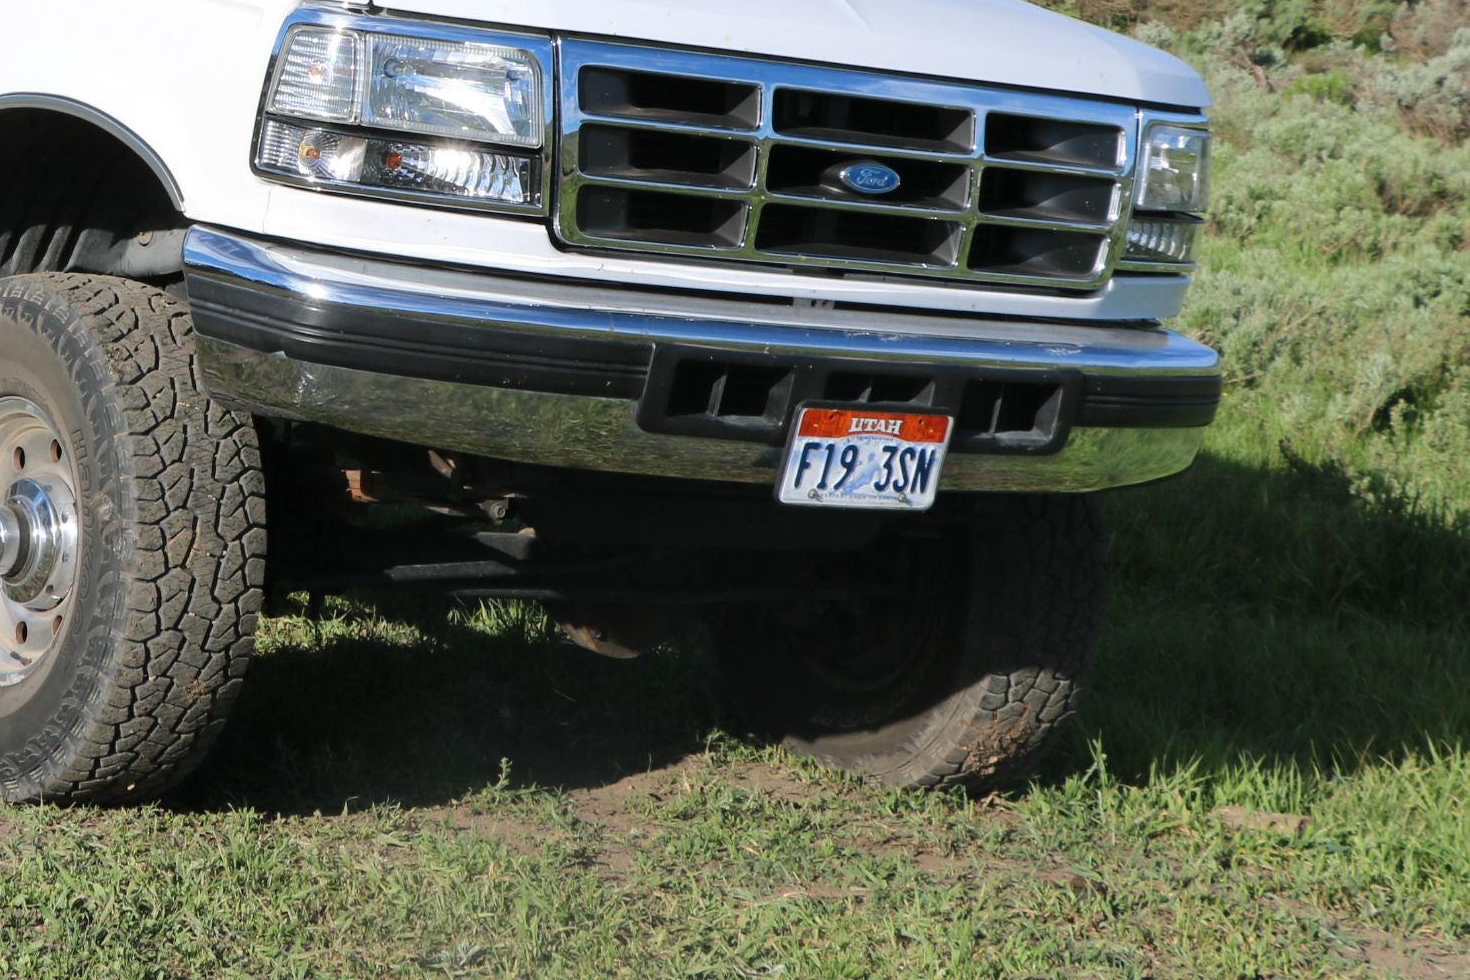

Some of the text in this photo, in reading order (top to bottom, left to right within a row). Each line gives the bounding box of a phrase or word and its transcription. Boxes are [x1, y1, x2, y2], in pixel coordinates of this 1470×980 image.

[856, 168, 888, 187] Ford
[848, 417, 904, 435] UTAH
[794, 442, 937, 494] F19 3SN
